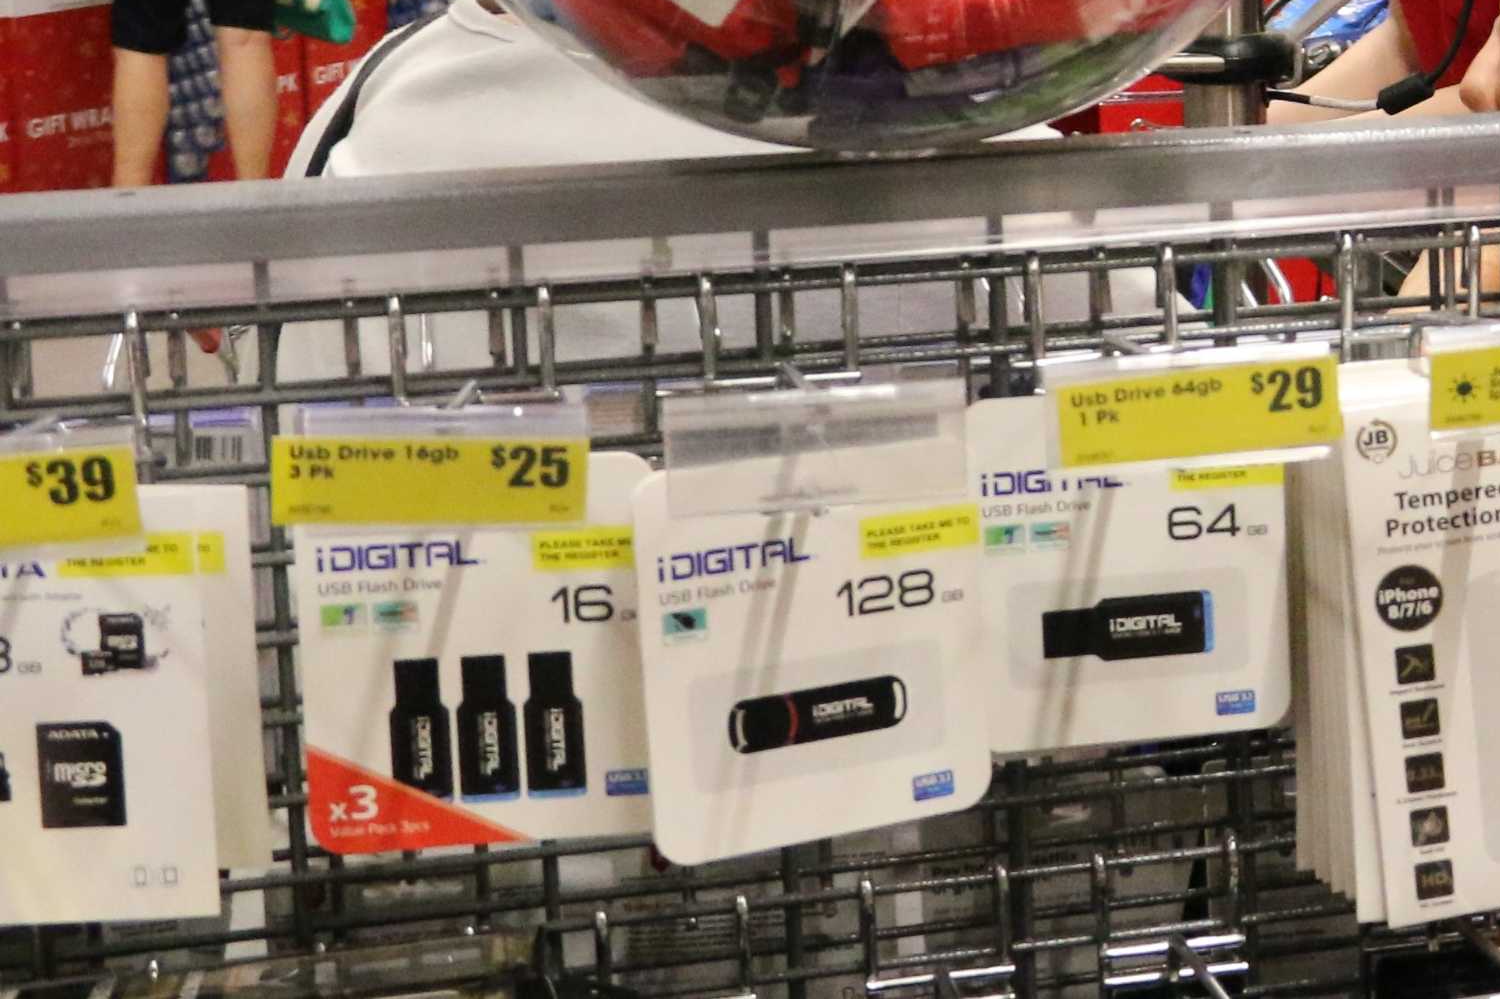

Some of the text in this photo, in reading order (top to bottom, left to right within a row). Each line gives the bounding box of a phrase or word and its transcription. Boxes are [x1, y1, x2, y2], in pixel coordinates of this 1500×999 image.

[276, 72, 298, 93] PK
[27, 112, 67, 139] GIFT
[69, 105, 113, 133] WRA
[1070, 379, 1223, 408] Usb Drive 64gb
[1250, 366, 1324, 414] $29
[1079, 408, 1120, 427] 1 Pk
[1363, 429, 1390, 448] JB
[288, 444, 460, 464] Usb Drive 16gb
[288, 464, 335, 481] 3 Pk
[490, 445, 571, 489] $25
[25, 455, 117, 506] $39
[982, 499, 1092, 519] USB Flash Drive
[865, 515, 971, 539] PLEASE TAKE ME TO
[1167, 502, 1241, 542] 64
[1246, 523, 1268, 536] GB
[538, 539, 582, 550] PLEASE
[866, 532, 942, 551] THE REGISTER
[315, 539, 479, 574] iDIGITAL
[657, 536, 812, 584] iDIGITAL
[317, 576, 443, 596] USB Flash Drive
[658, 577, 776, 607] USB Flash Drive
[835, 567, 936, 618] 128
[1378, 584, 1439, 604] iPhone
[549, 583, 615, 625] 16
[1387, 602, 1434, 621] 8/7/6
[1108, 613, 1183, 633] iDIGITAL
[328, 784, 379, 822] x3
[330, 823, 365, 838] Value
[367, 821, 397, 836] Pack
